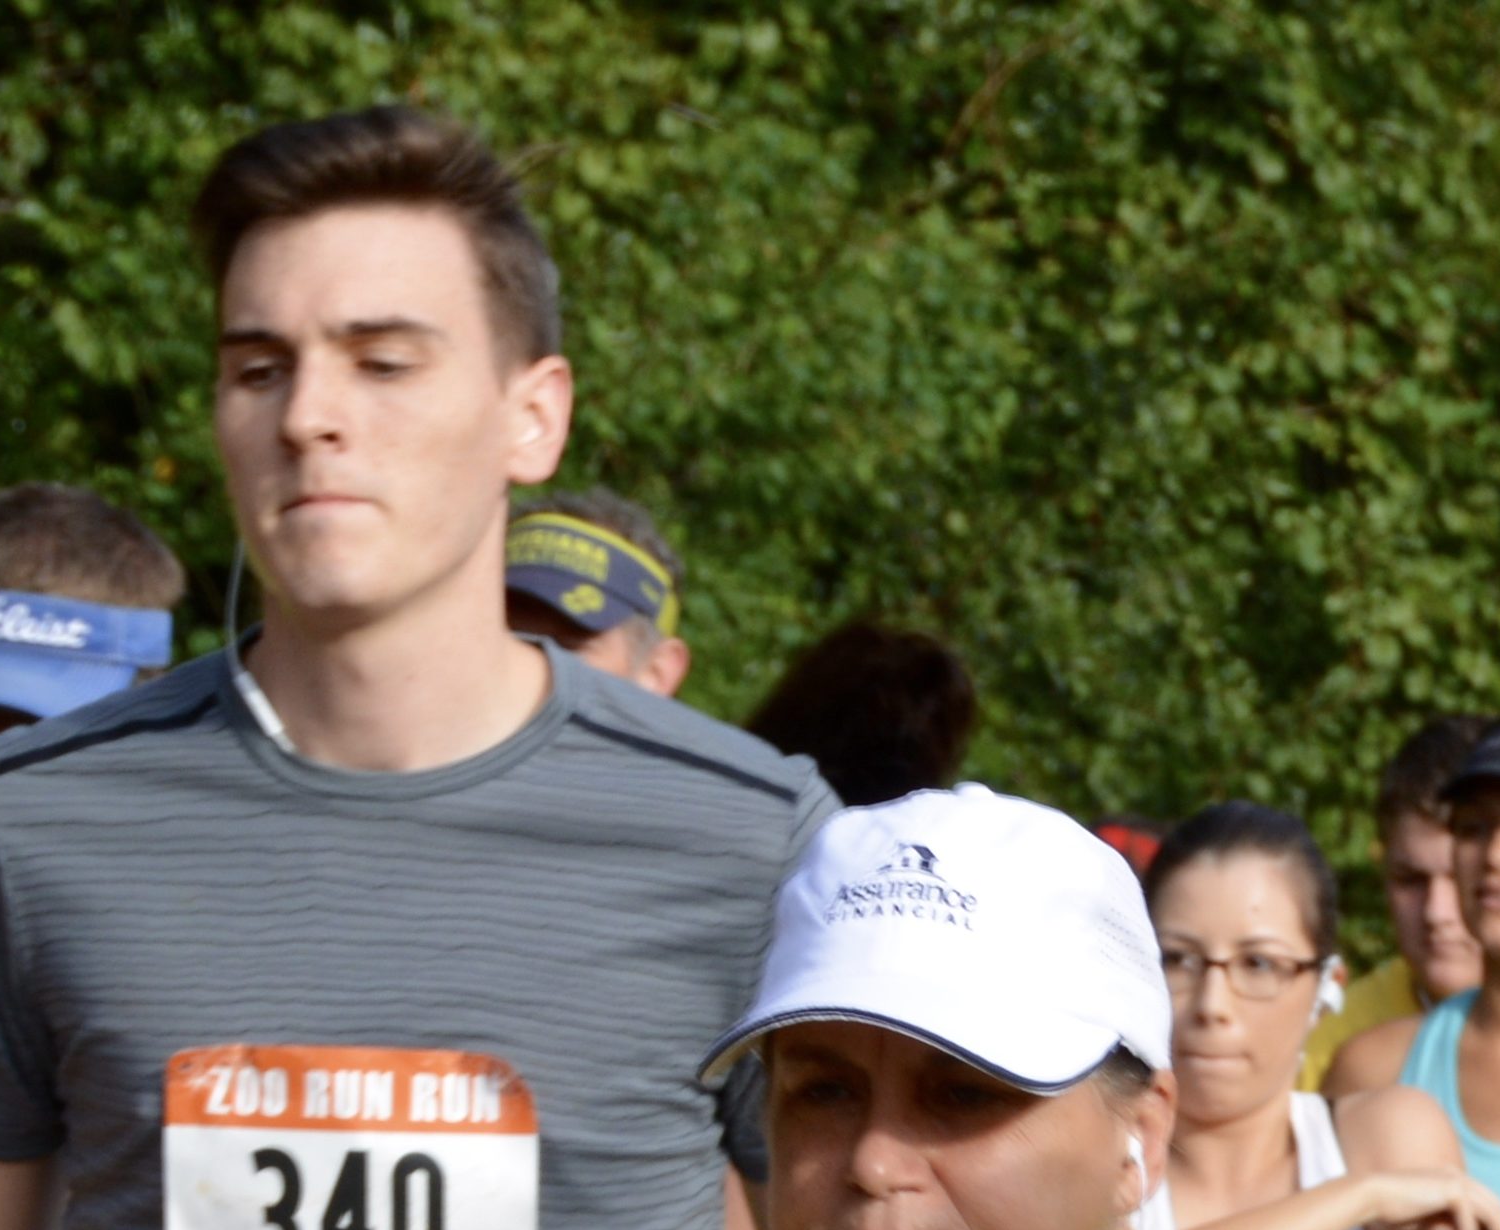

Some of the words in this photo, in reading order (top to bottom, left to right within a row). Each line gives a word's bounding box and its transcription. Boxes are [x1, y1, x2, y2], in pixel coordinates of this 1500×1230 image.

[831, 880, 977, 914] Assurance
[823, 902, 974, 932] FINANCIAL
[206, 1065, 289, 1117] ZOO
[303, 1069, 395, 1121] RUN
[410, 1072, 502, 1124] RUN
